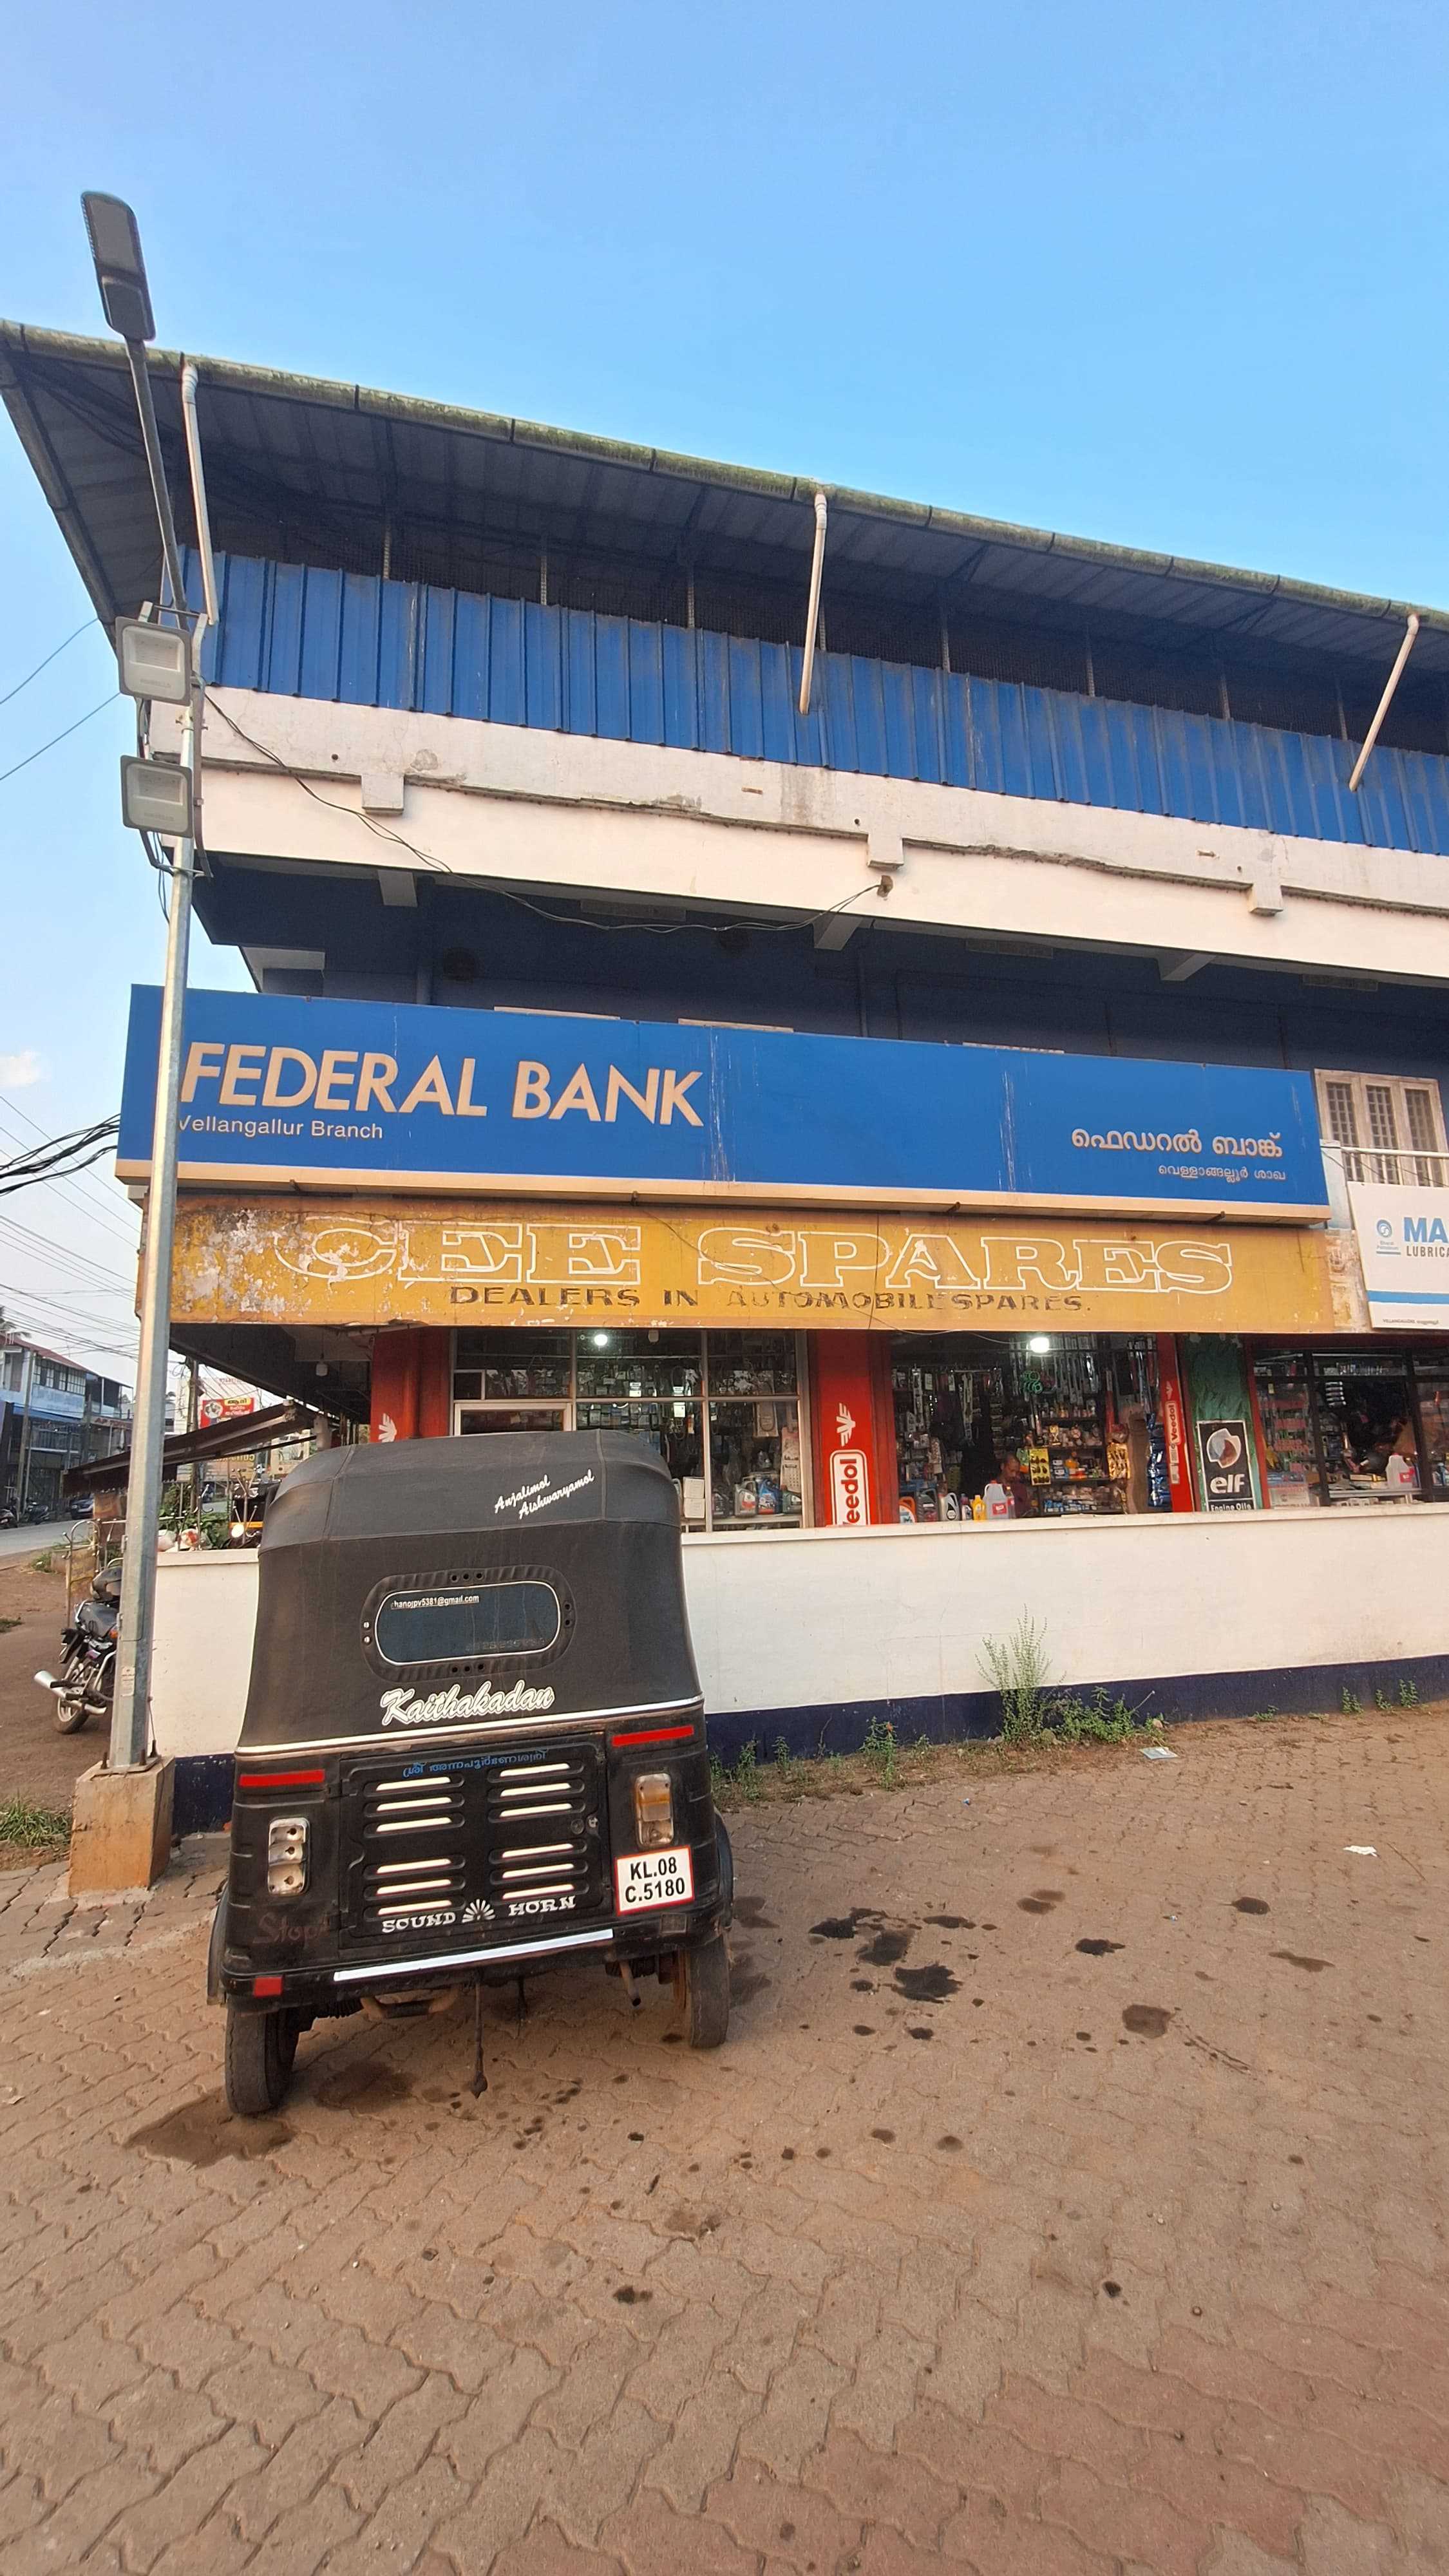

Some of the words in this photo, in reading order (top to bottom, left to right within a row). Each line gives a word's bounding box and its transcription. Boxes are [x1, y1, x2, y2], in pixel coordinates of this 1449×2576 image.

[180, 1041, 487, 1117] FEDERAL
[512, 1060, 704, 1127] BANK
[180, 1115, 304, 1137] Vellangallur
[311, 1121, 383, 1139] Branch
[1072, 1128, 1202, 1153] ഫെഡറൽ
[1212, 1132, 1283, 1157] ബാങ്ക്
[1254, 1169, 1286, 1180] ശാഖ
[273, 1215, 641, 1283] CEE
[697, 1227, 1233, 1294] SPARES
[450, 1286, 641, 1307] DEALERS
[663, 1289, 699, 1307] IN
[1168, 1405, 1178, 1440] Veedol
[495, 1474, 551, 1513] Anjalimol
[518, 1468, 595, 1520] Aishwaryamol
[839, 1458, 861, 1525] eedol
[1210, 1473, 1245, 1493] elf
[380, 1680, 555, 1726] Kaithakadan
[630, 1857, 677, 1880] KL.08
[625, 1877, 685, 1903] C.5180
[381, 1911, 457, 1933] SOUND
[507, 1895, 576, 1917] HORN
